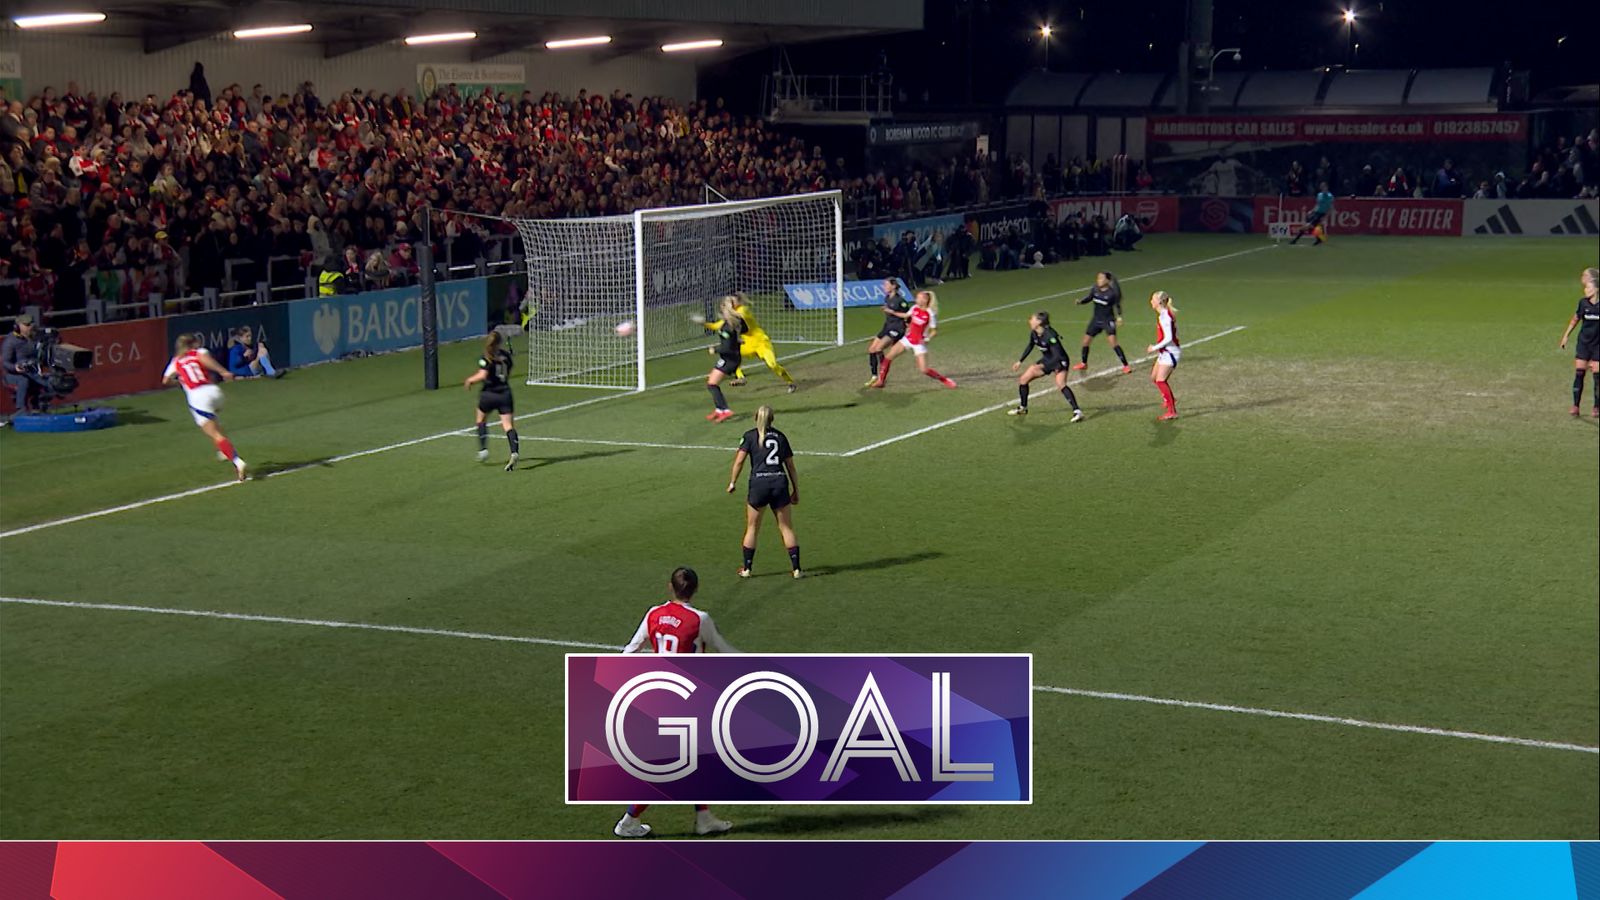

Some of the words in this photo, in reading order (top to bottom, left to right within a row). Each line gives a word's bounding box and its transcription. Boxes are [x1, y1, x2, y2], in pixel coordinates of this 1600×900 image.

[1154, 122, 1232, 136] HARRINGTONS
[1234, 122, 1258, 135] CAR
[1260, 122, 1296, 135] SALES
[1263, 205, 1361, 229] Emites
[1369, 207, 1400, 229] FLY
[1400, 206, 1454, 230] BETTER
[814, 283, 906, 304] BARCLAS
[192, 323, 268, 350] OMEA
[94, 341, 143, 366] EGA
[765, 438, 779, 465] 2
